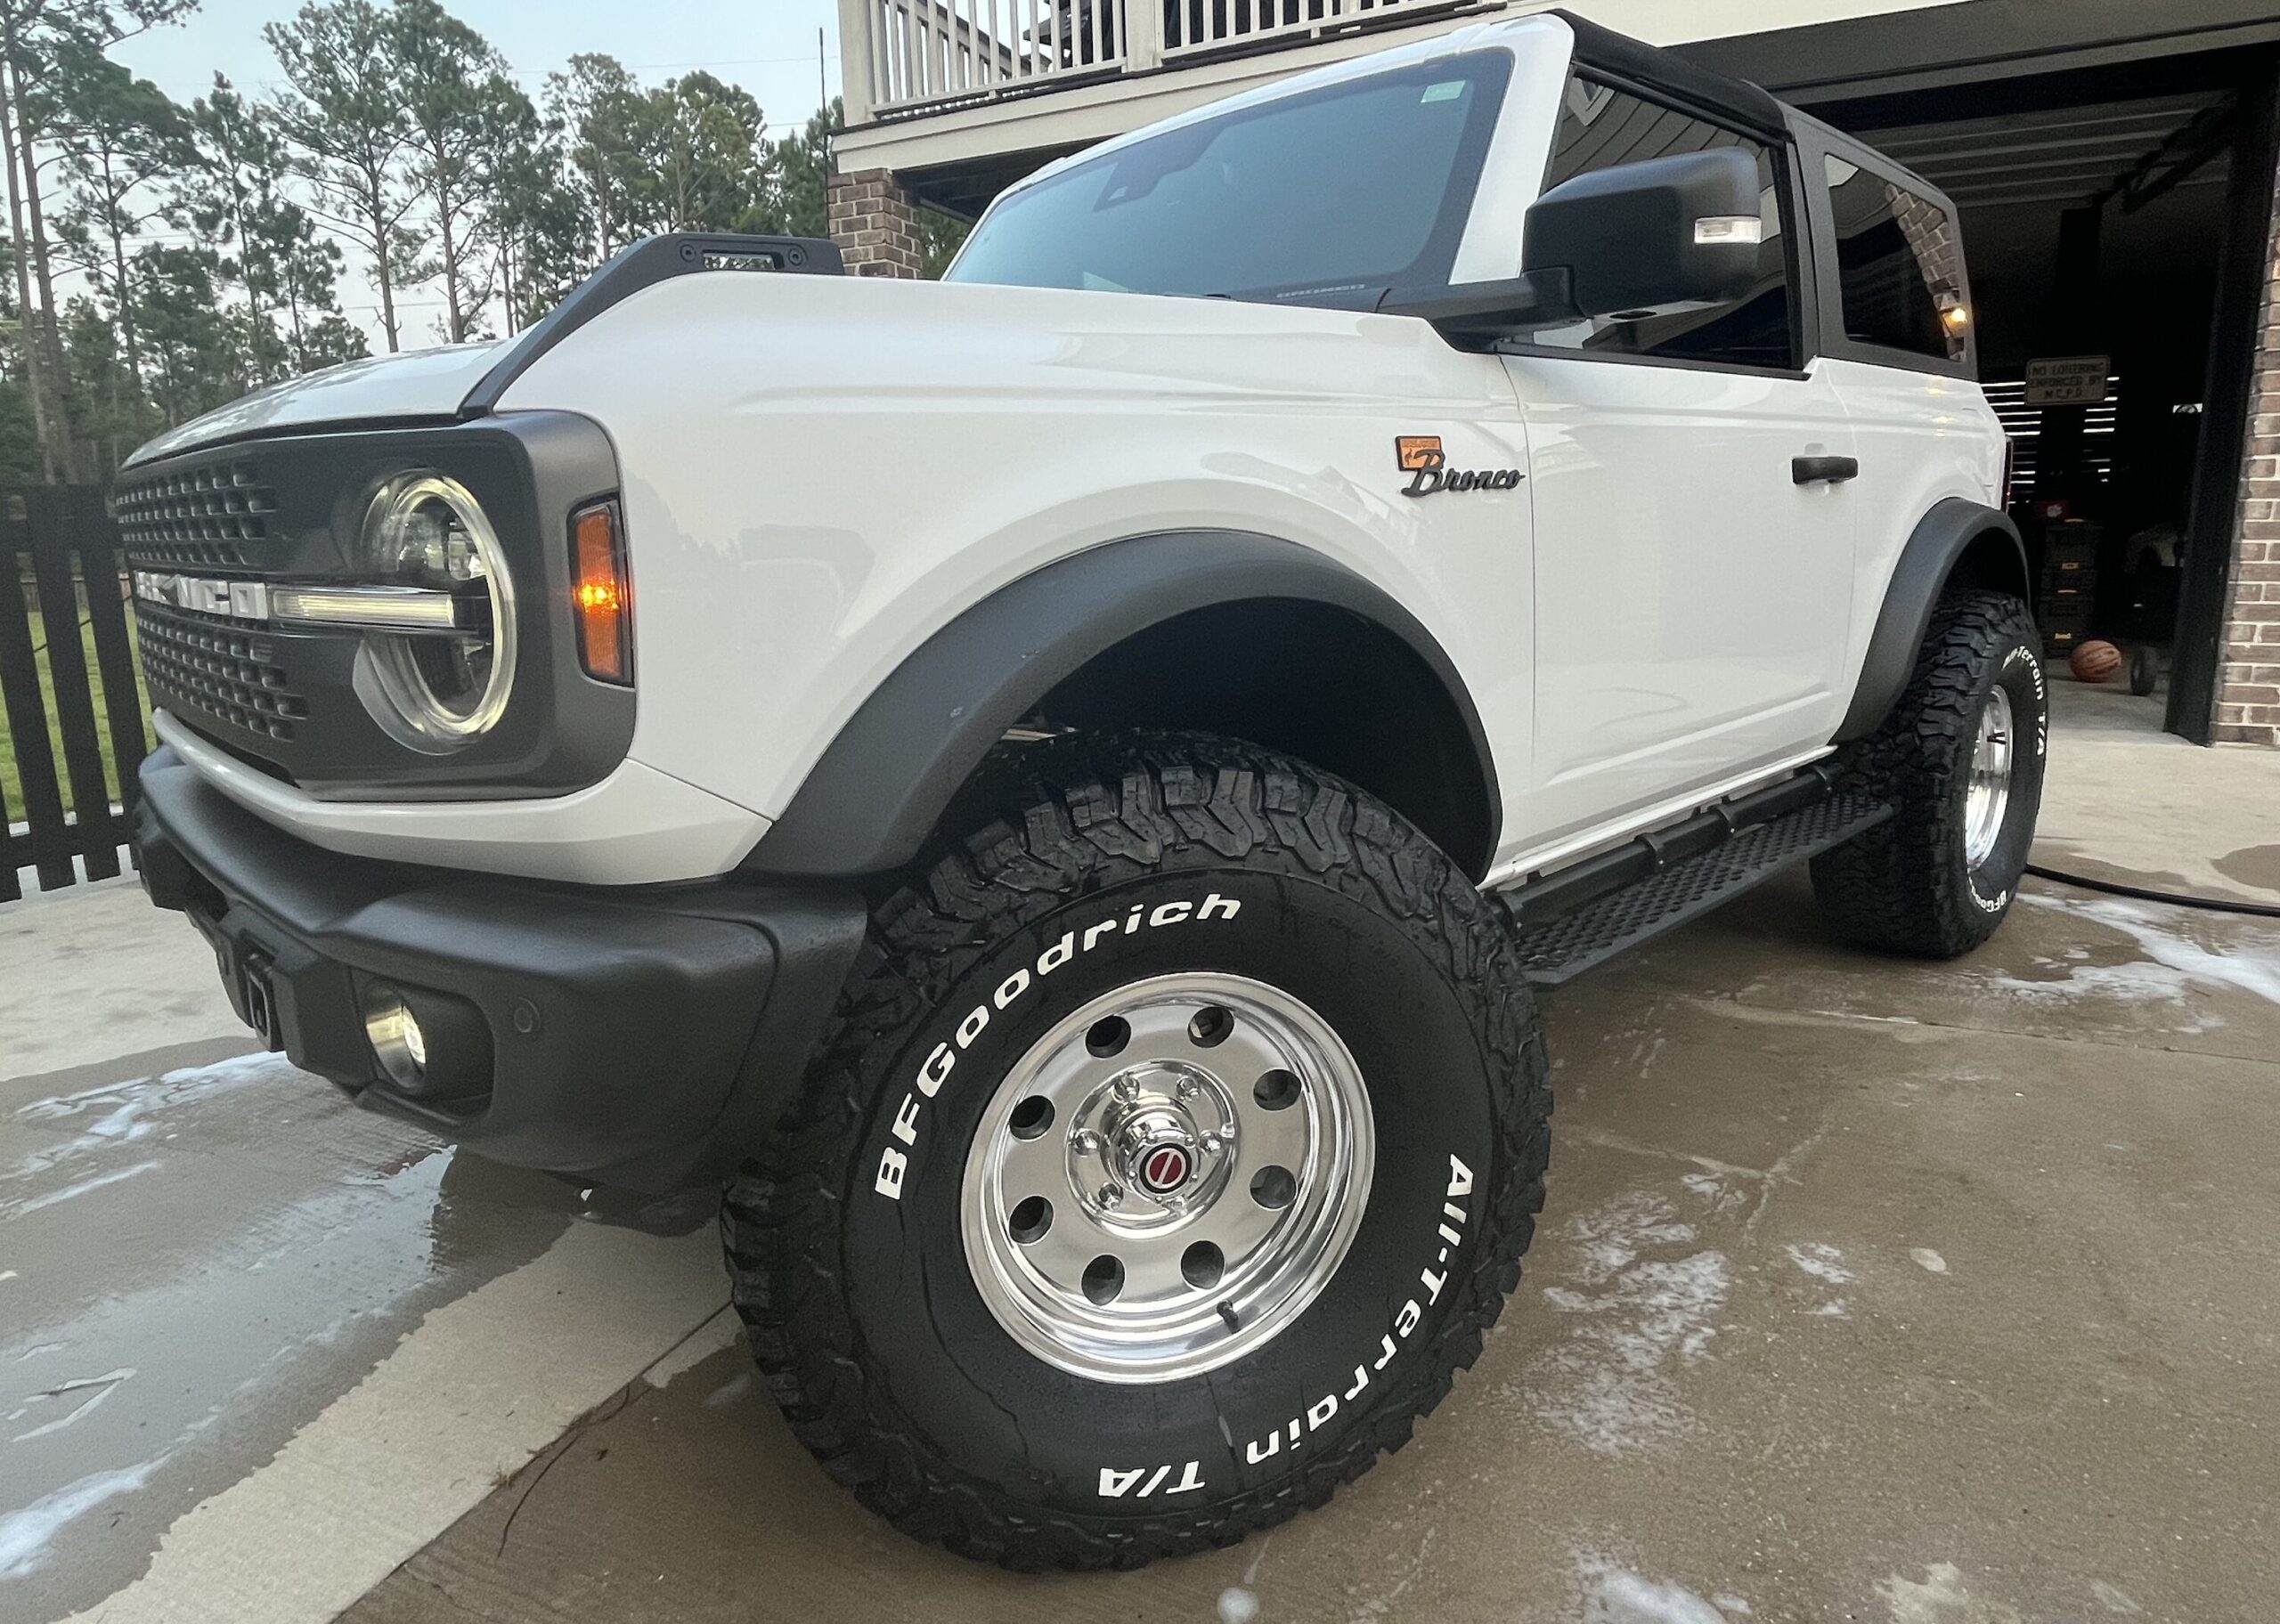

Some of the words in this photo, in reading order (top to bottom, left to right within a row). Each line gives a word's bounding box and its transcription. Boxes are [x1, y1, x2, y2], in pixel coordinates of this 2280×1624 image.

[1401, 449, 1526, 498] Bronco
[875, 893, 1242, 1199] BFGoodrich
[1246, 1154, 1474, 1466] All-Terrain
[1098, 1460, 1205, 1498] T/A
